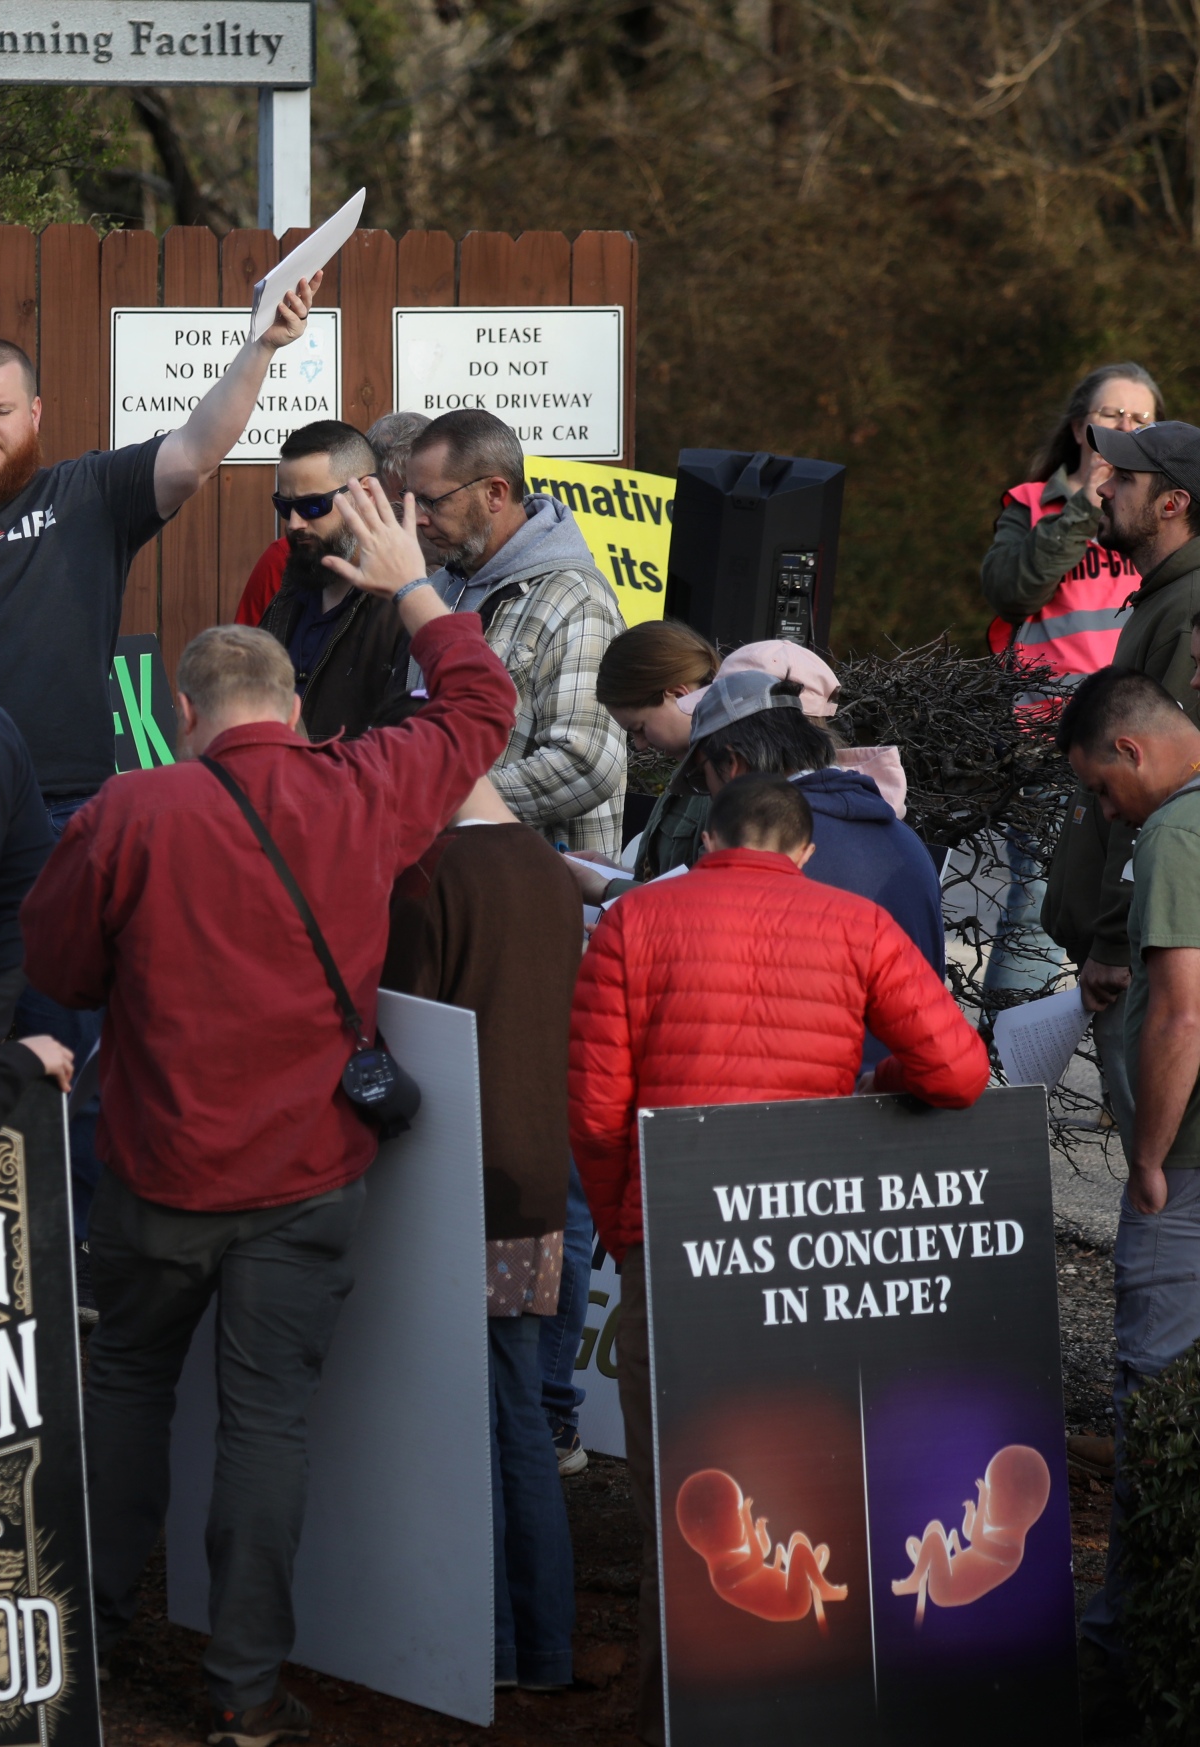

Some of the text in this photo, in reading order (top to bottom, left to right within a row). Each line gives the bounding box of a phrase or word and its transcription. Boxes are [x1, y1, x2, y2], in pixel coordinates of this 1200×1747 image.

[129, 18, 285, 65] Facility
[174, 329, 212, 346] POR
[476, 327, 543, 344] PLEASE
[165, 363, 194, 379] NO
[469, 360, 549, 377] DO NOT
[424, 392, 593, 410] BLOCK DRIVEWAY
[552, 425, 589, 441] CAR
[7, 503, 57, 542] LIFE
[607, 543, 663, 594] its
[713, 1168, 989, 1222] WHICH BABY
[682, 1219, 1025, 1278] WAS CONCIEVED
[761, 1275, 952, 1326] IN RAPE?
